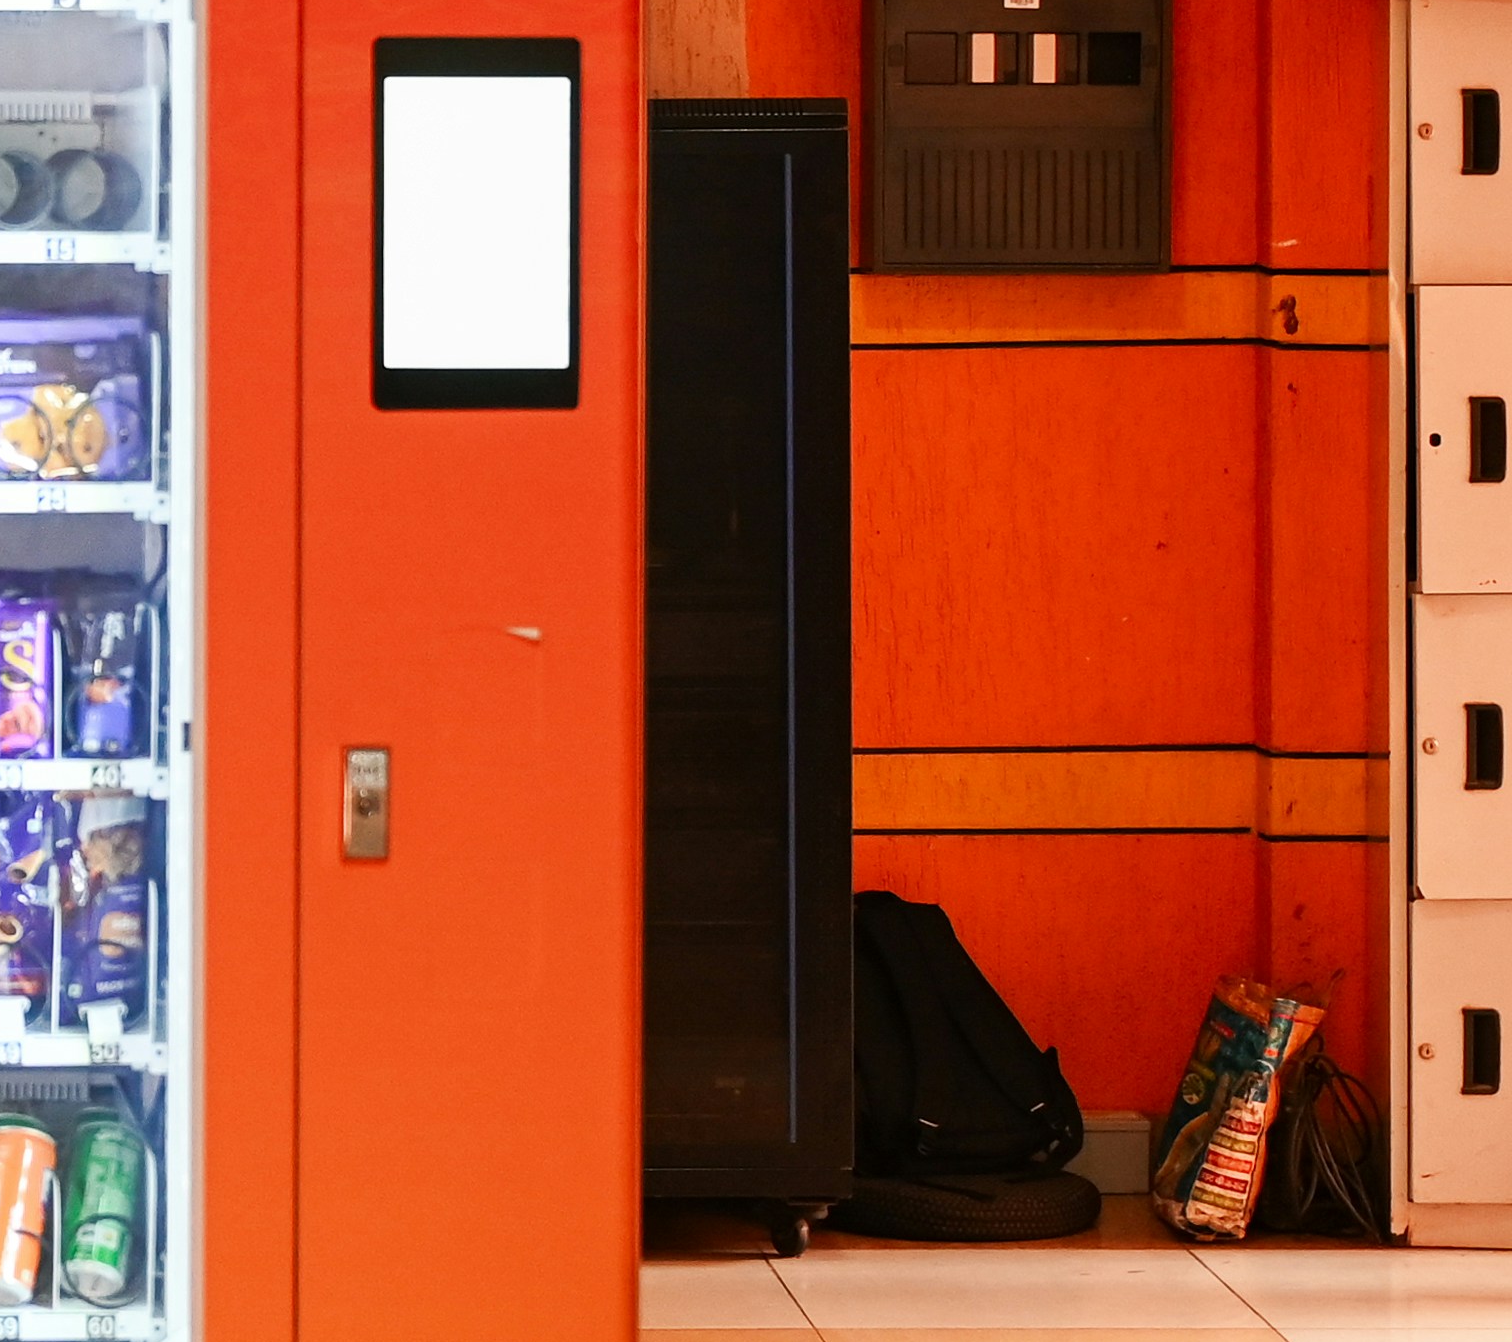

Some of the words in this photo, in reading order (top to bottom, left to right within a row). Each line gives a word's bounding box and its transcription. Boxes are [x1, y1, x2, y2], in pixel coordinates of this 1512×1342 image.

[92, 765, 121, 789] 40
[90, 1043, 119, 1064] 50
[87, 1315, 115, 1340] 60
